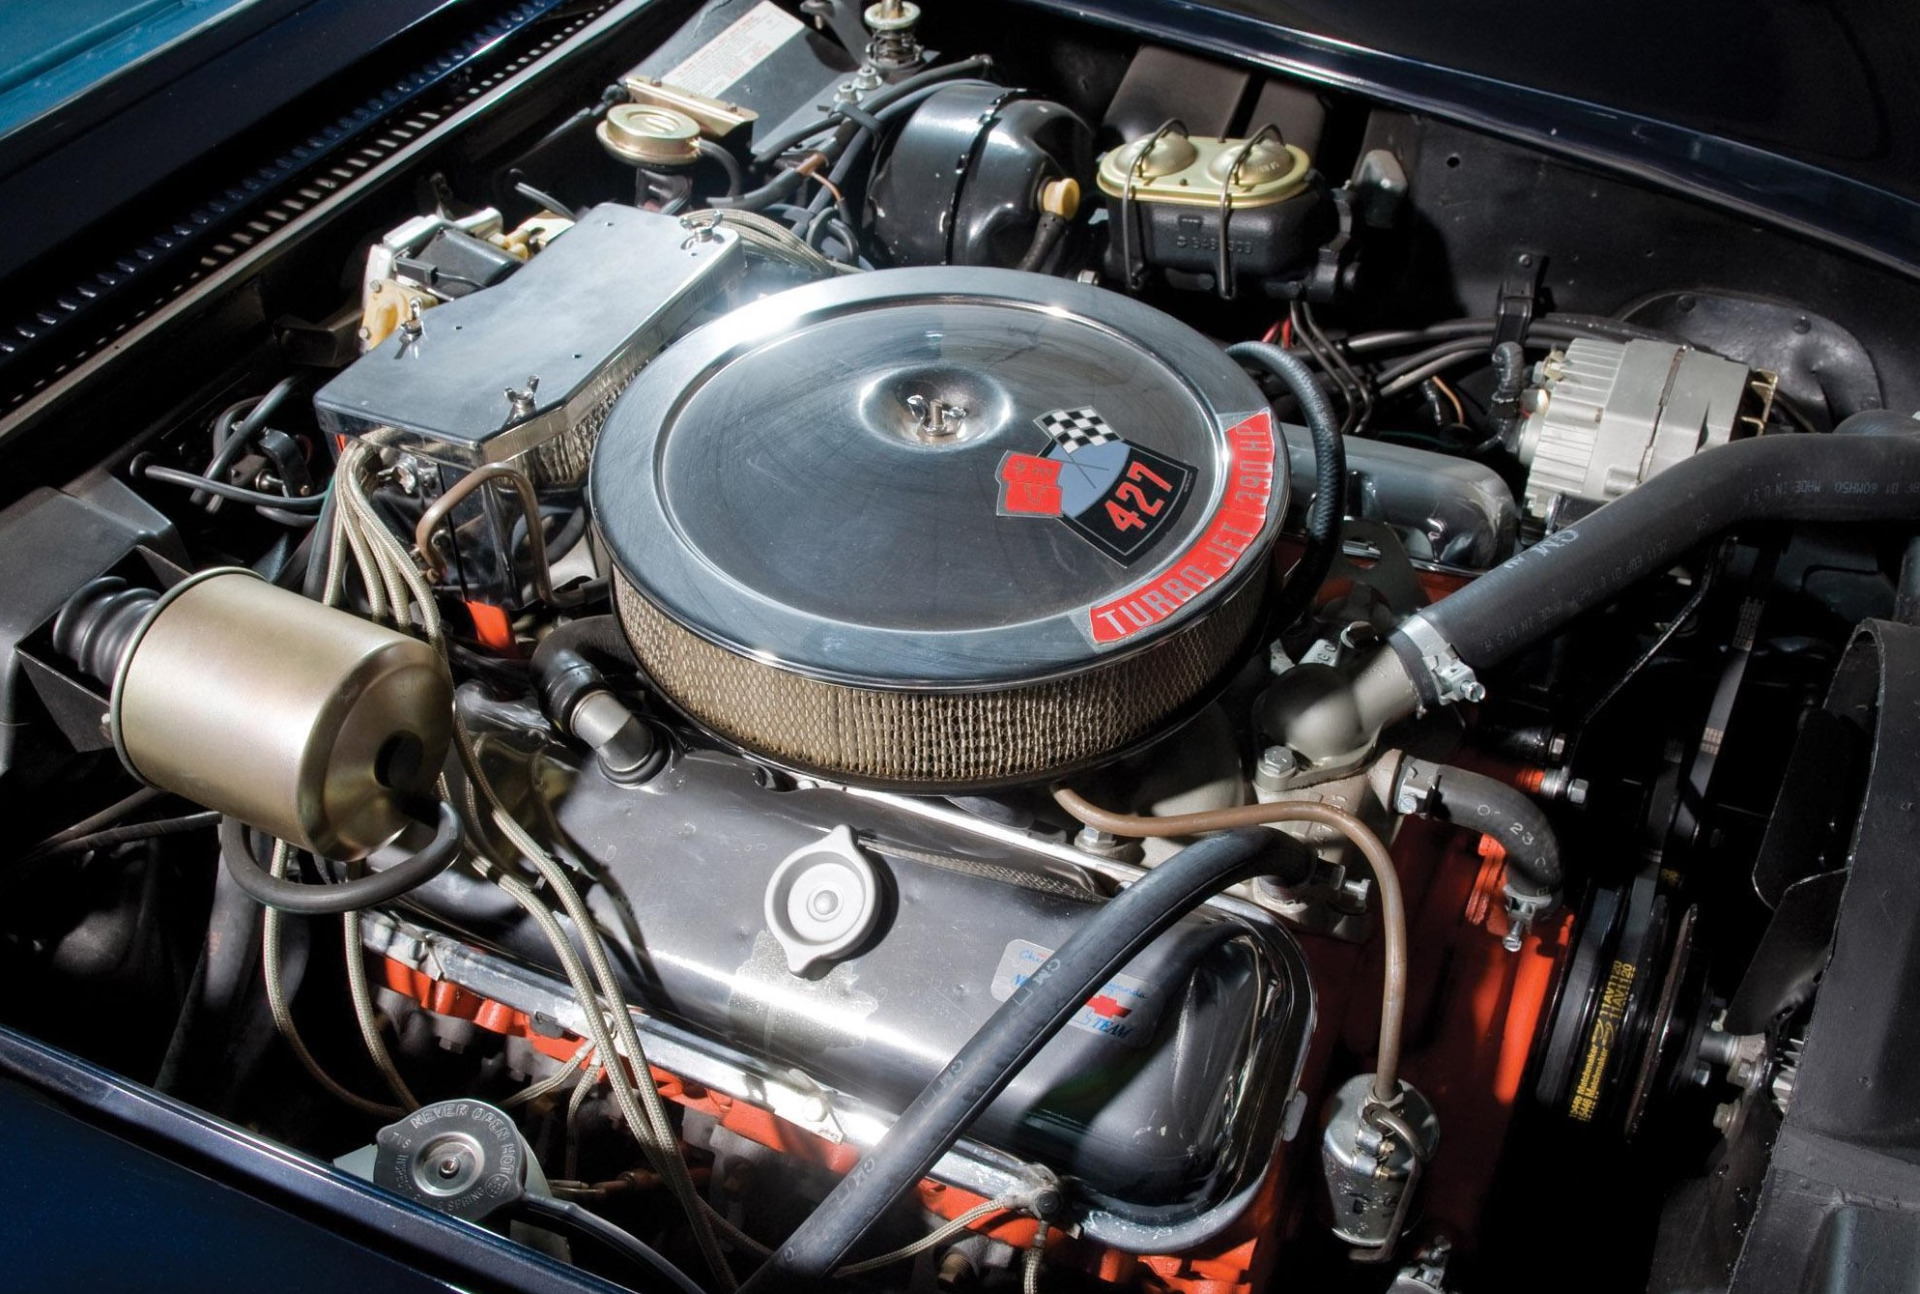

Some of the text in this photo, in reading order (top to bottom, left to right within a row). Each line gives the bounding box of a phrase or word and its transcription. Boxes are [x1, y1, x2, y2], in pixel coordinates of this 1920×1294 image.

[1105, 461, 1173, 532] 427
[1795, 480, 1822, 494] MADE
[1585, 1046, 1609, 1098] Matchmaker
[1608, 963, 1633, 1020] 11AV1120
[1577, 1044, 1599, 1095] Matchmaker
[410, 1103, 516, 1174] NEVER OPEN HOT
